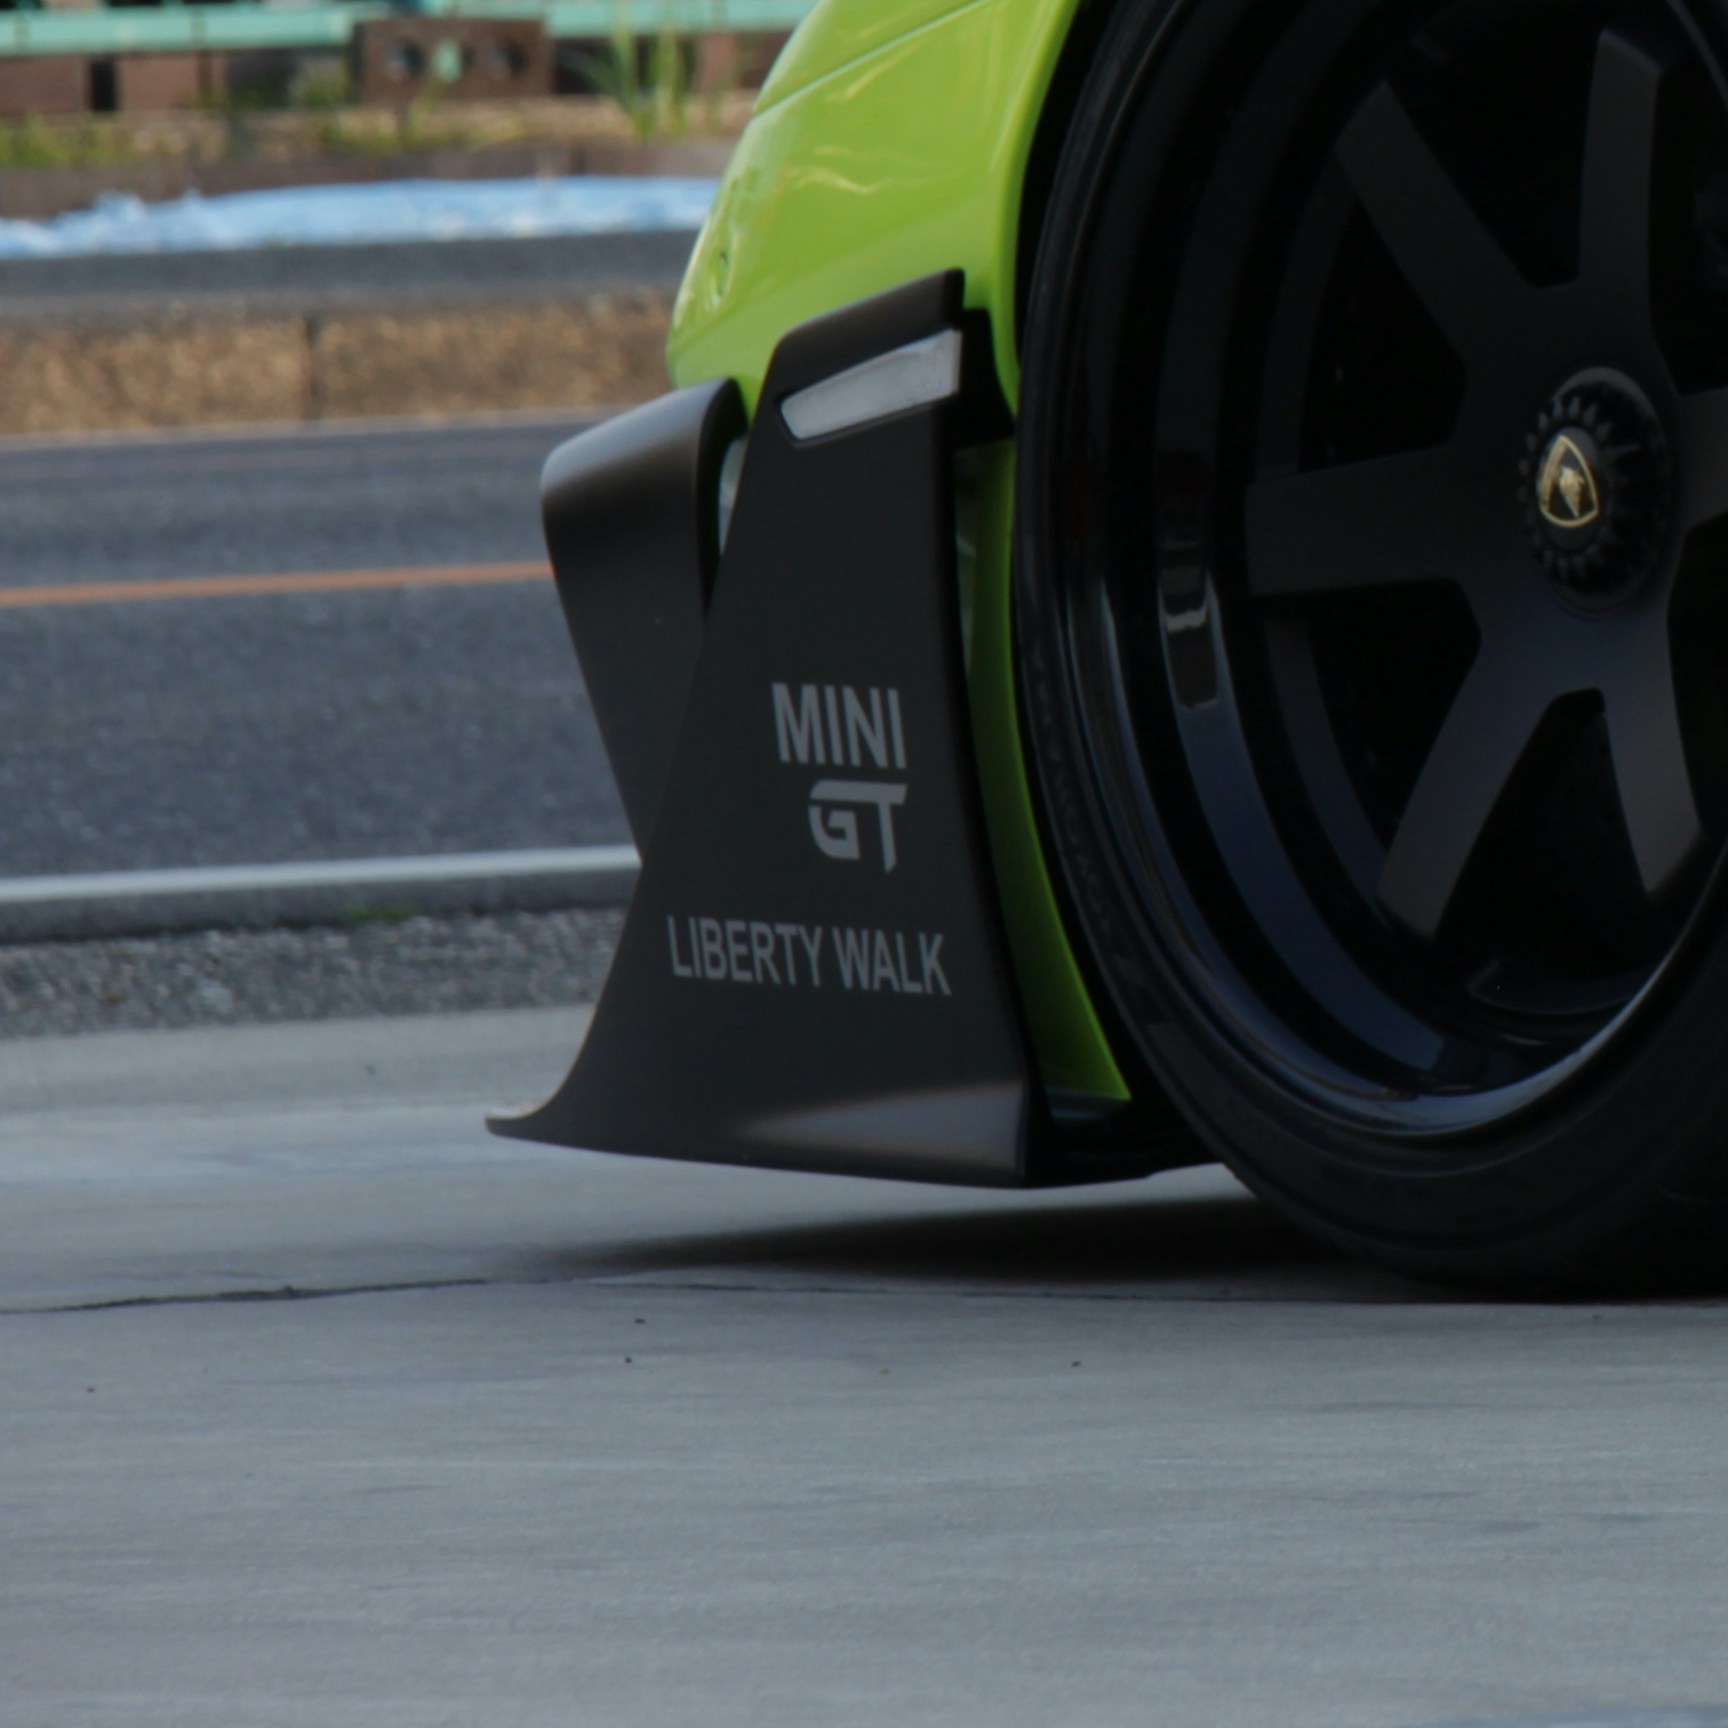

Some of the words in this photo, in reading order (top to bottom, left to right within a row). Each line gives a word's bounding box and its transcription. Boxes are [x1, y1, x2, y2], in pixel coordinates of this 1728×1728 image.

[772, 682, 907, 770] MINI
[808, 779, 907, 872] GT
[667, 915, 823, 988] LIBERTY
[832, 926, 952, 996] WALK
